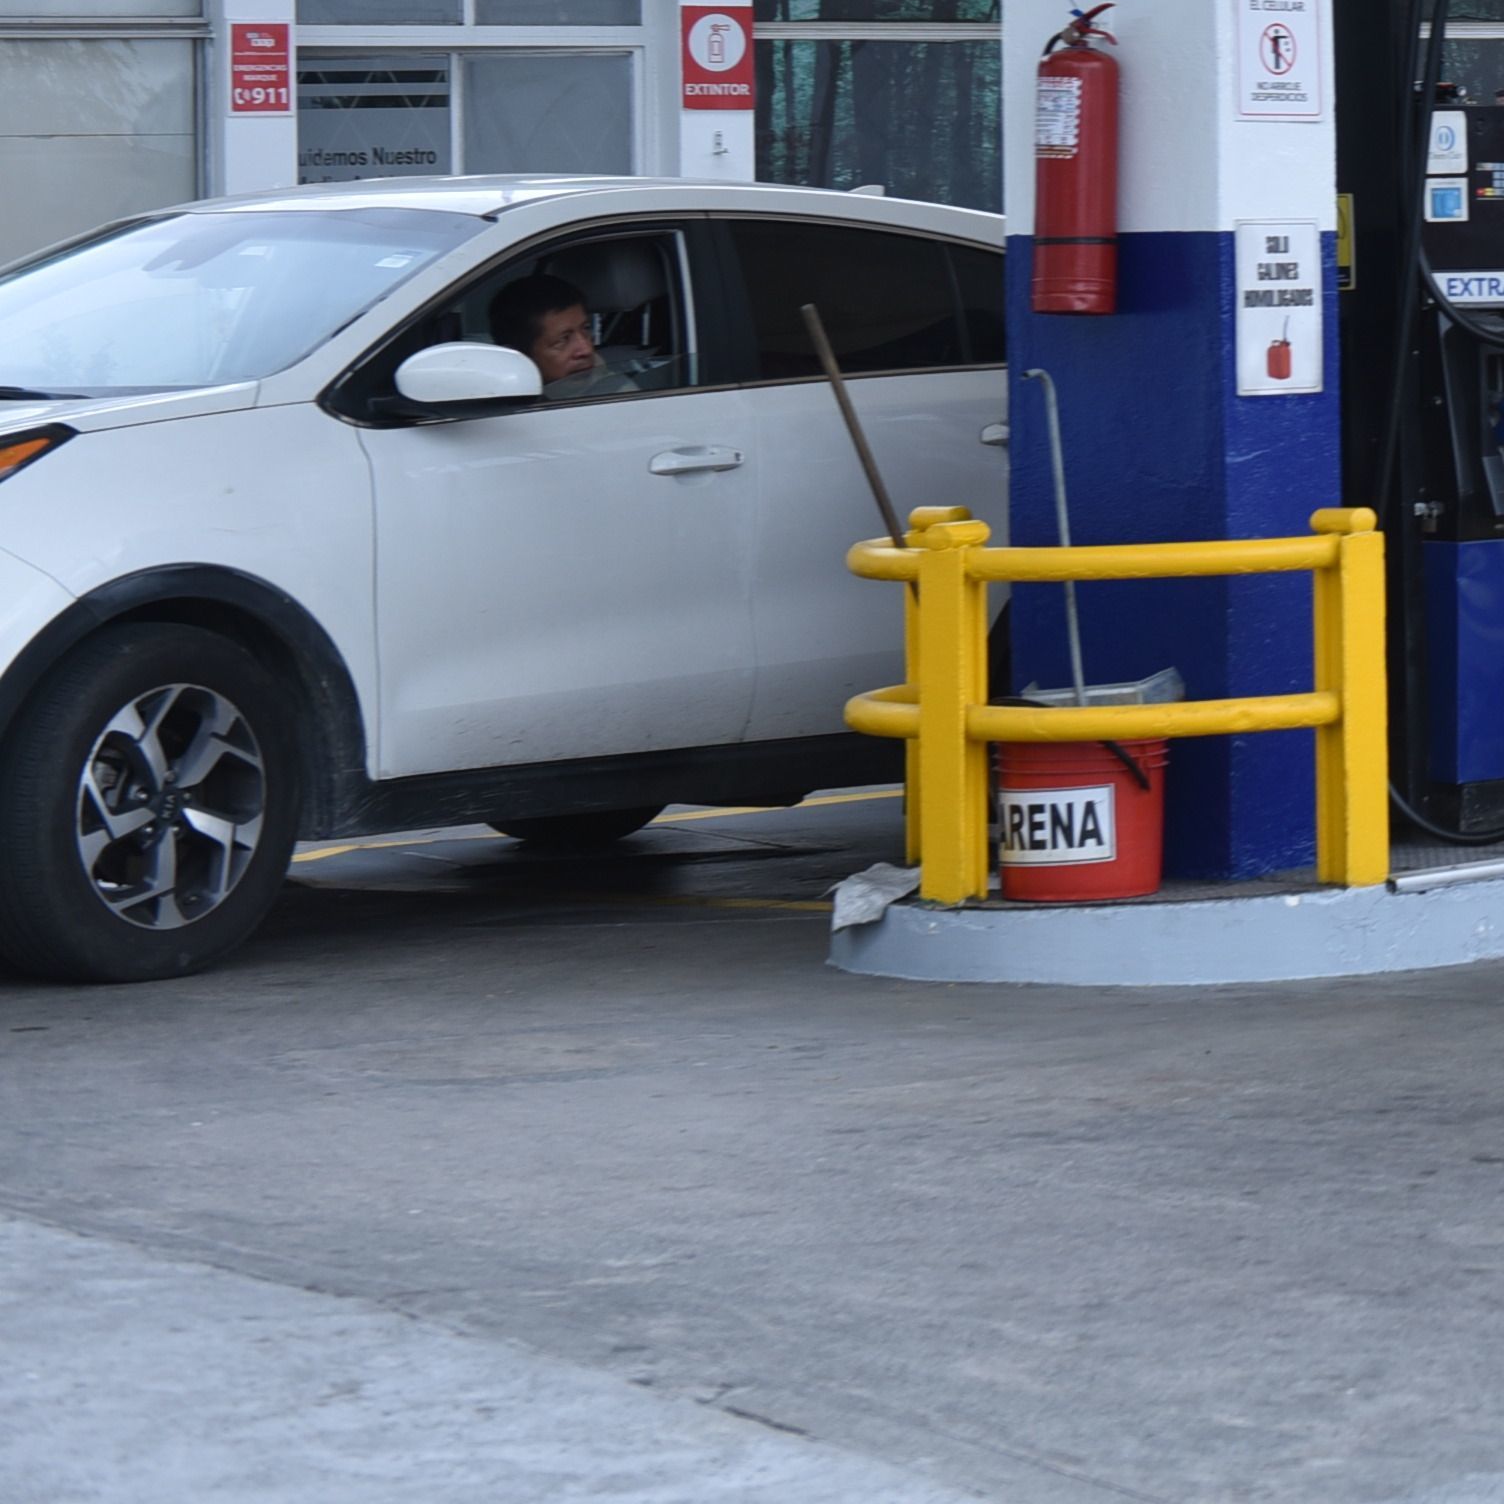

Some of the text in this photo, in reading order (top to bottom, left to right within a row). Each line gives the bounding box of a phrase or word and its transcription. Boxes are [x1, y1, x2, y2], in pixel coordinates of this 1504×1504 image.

[1262, 0, 1306, 12] CELULAR
[252, 87, 288, 105] 911
[684, 83, 751, 96] EXTINTOR
[298, 147, 438, 167] uidemos Nuestro
